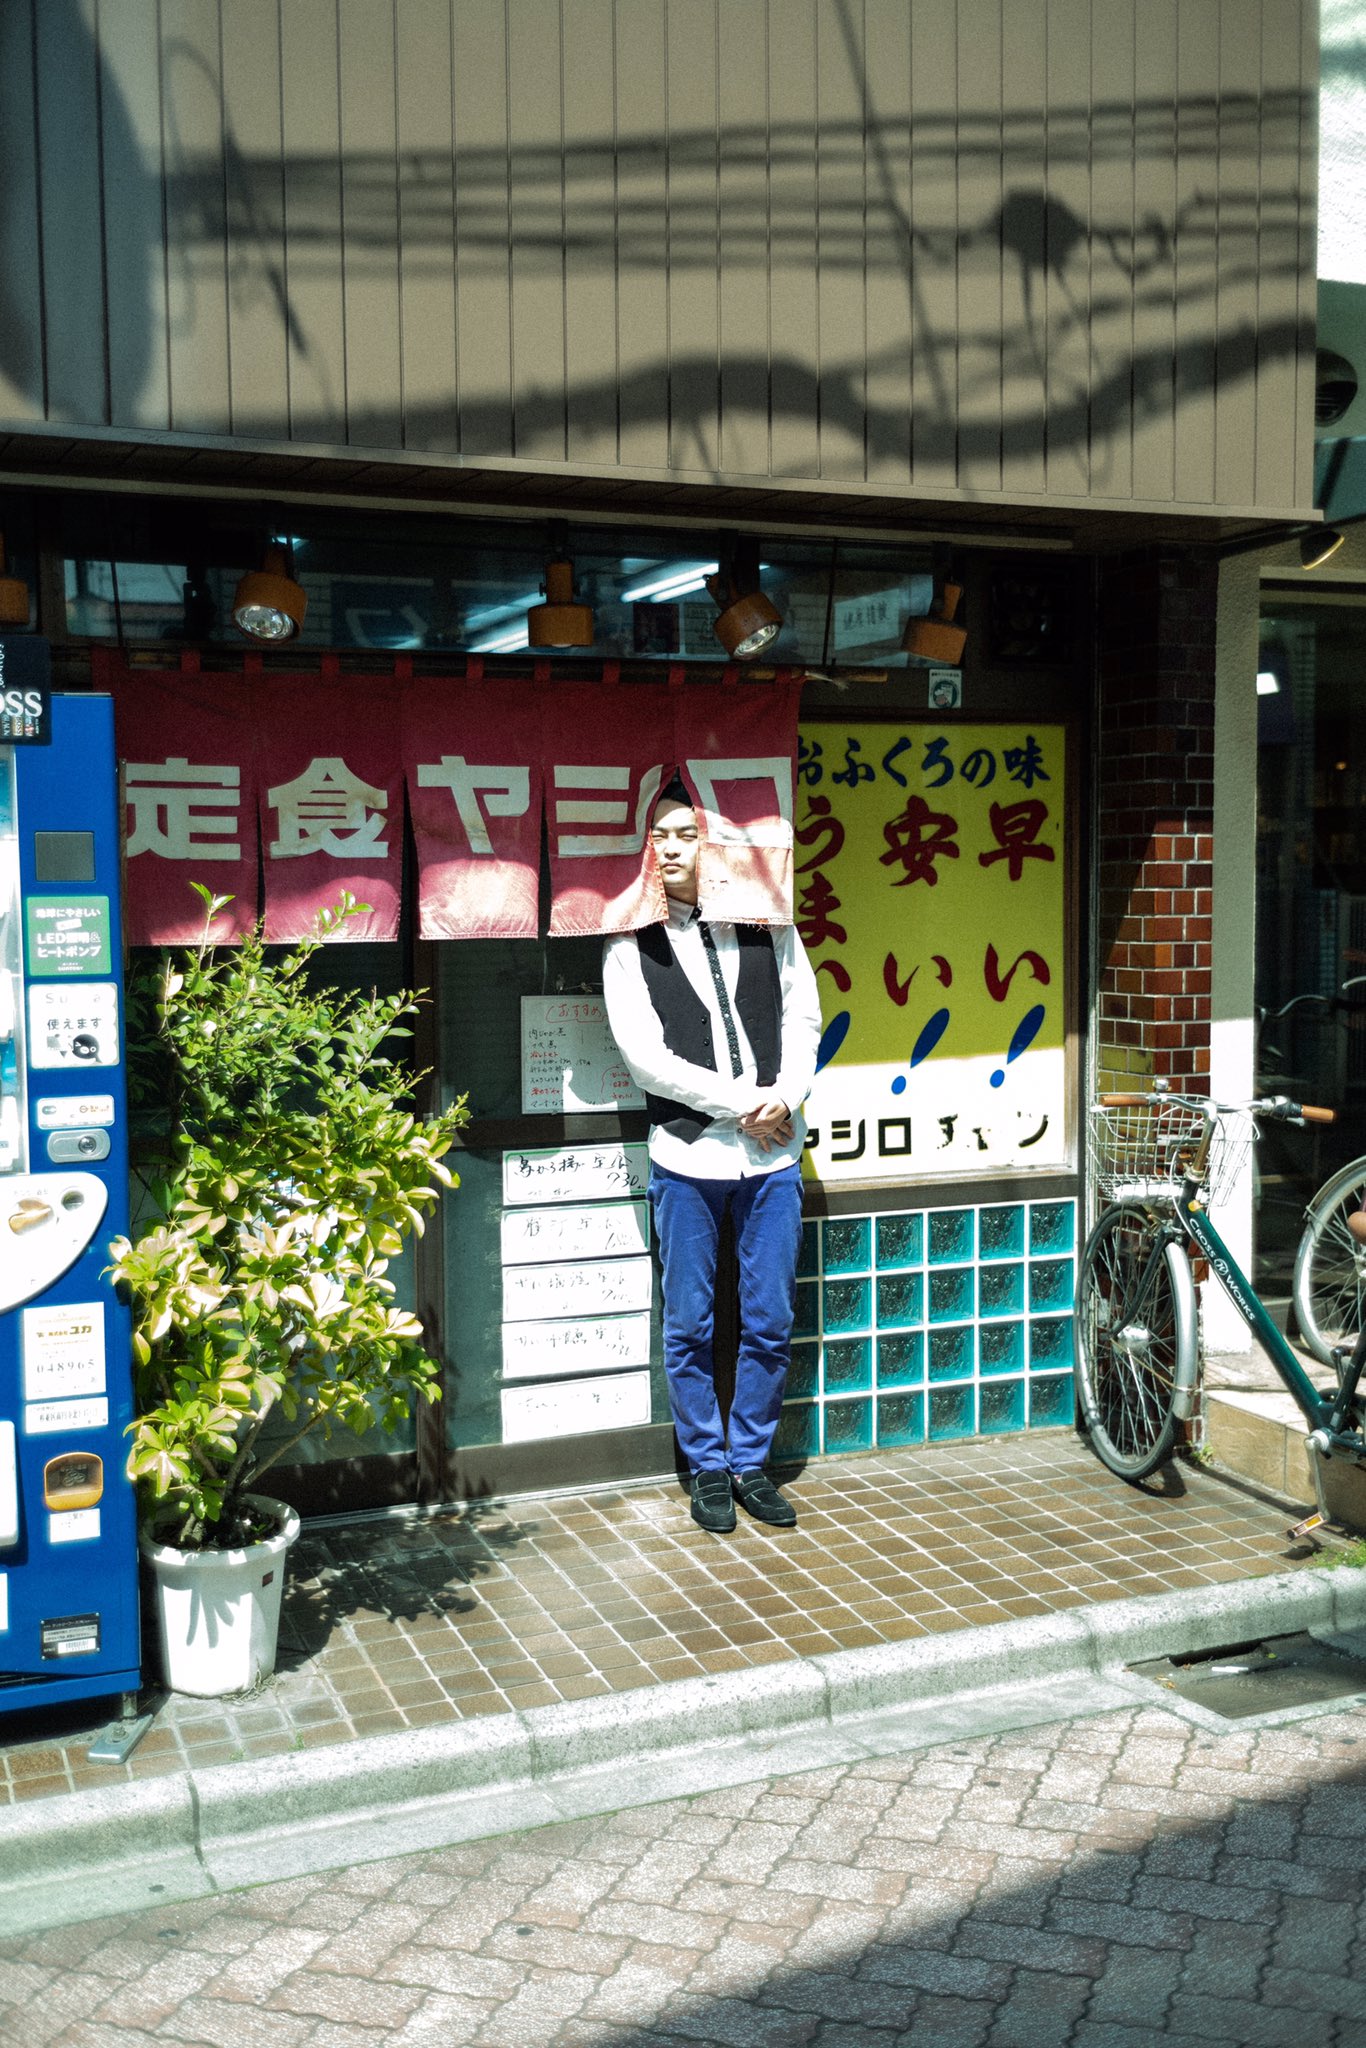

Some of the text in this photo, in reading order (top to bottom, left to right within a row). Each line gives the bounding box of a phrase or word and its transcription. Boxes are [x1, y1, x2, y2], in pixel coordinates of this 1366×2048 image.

[798, 735, 1051, 788] おふくろの味
[37, 945, 102, 958] ヒートポンプ
[47, 1016, 102, 1031] 使えます
[1189, 1218, 1256, 1321] CROSS WORKS
